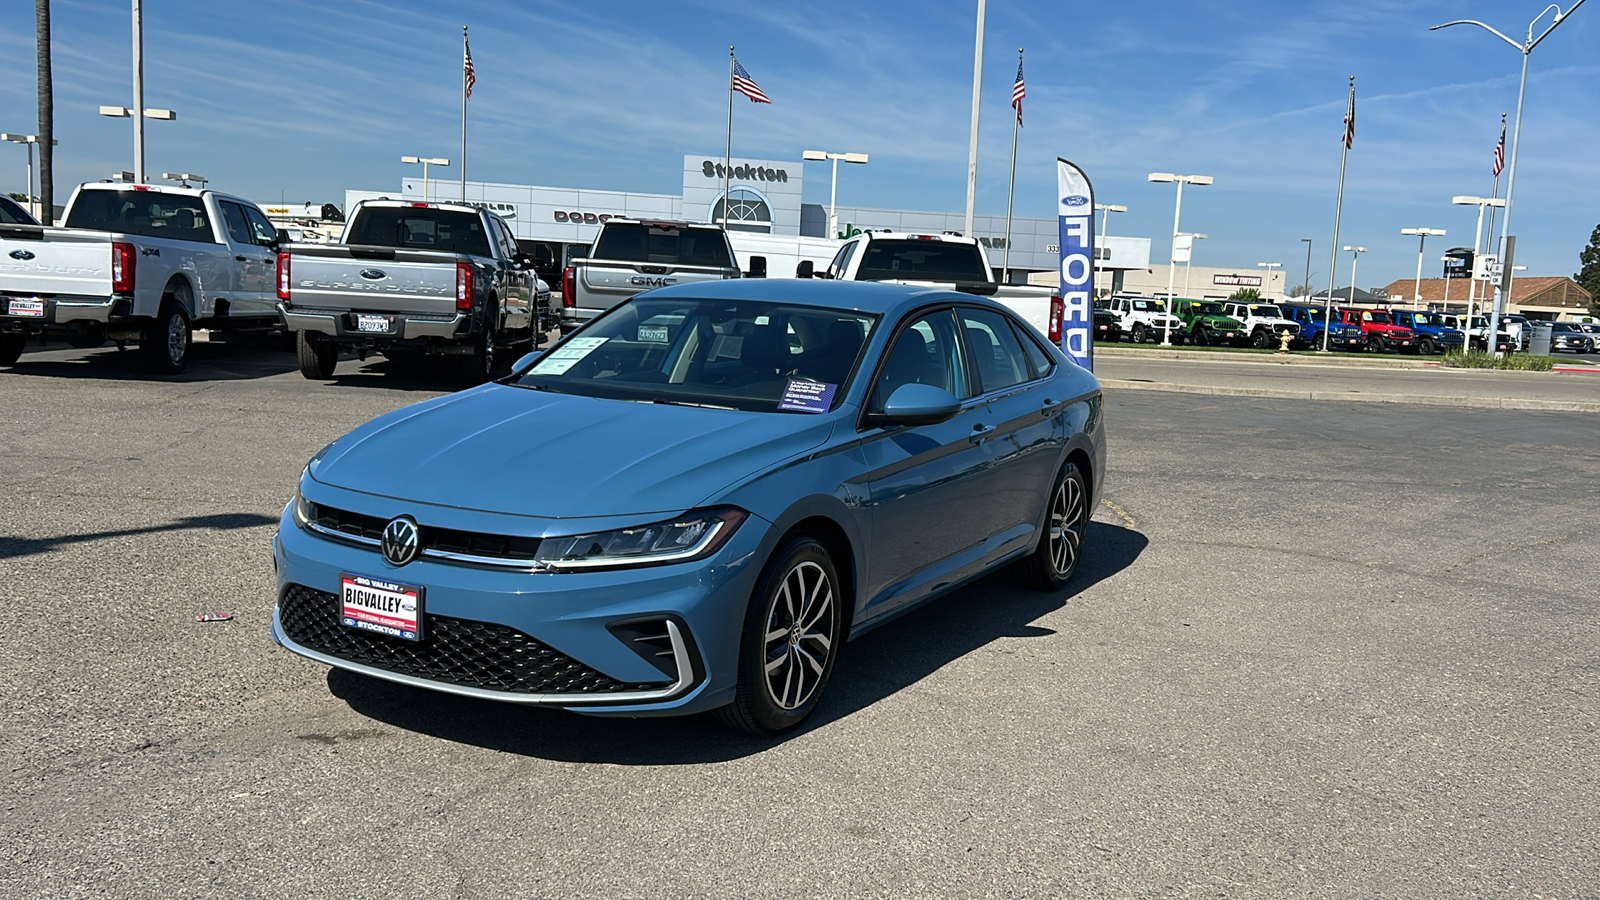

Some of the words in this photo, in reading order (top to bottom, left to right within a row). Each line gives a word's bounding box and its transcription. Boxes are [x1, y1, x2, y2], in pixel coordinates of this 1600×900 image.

[702, 160, 788, 183] Stockton
[300, 280, 380, 291] SUPER
[386, 284, 448, 294] DUTY
[631, 276, 678, 287] GMC
[356, 577, 371, 586] BIG
[371, 580, 399, 591] VALLEY
[345, 587, 402, 613] BIGVALLEY
[357, 621, 401, 635] STOCKTON
